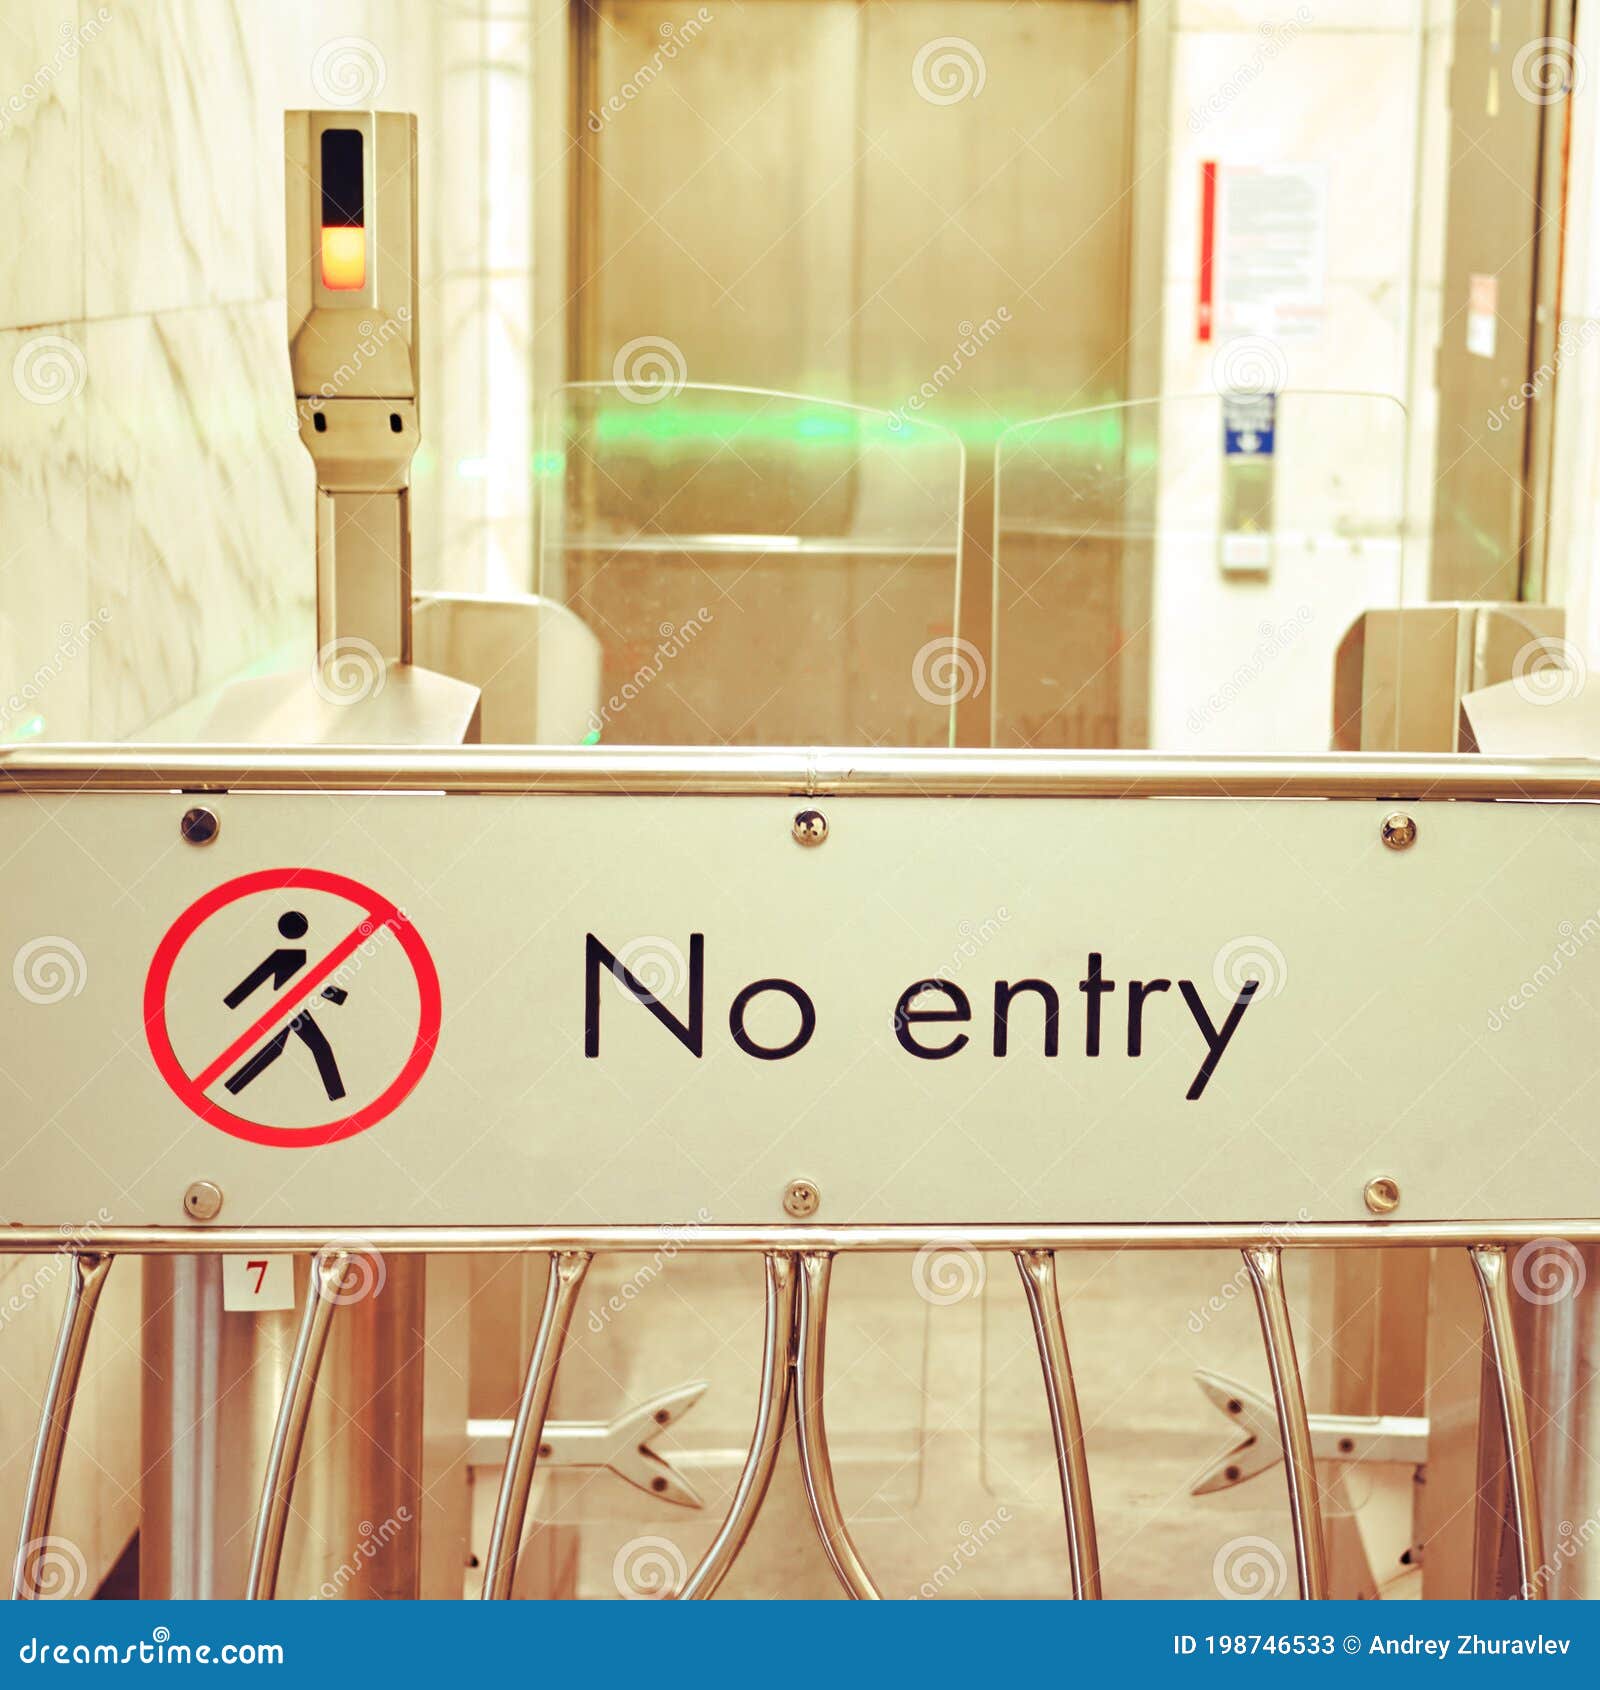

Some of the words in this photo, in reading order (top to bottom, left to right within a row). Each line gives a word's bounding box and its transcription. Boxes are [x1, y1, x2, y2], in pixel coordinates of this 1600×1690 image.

[584, 932, 816, 1060] No
[894, 952, 1260, 1101] entry
[246, 1261, 268, 1294] 7
